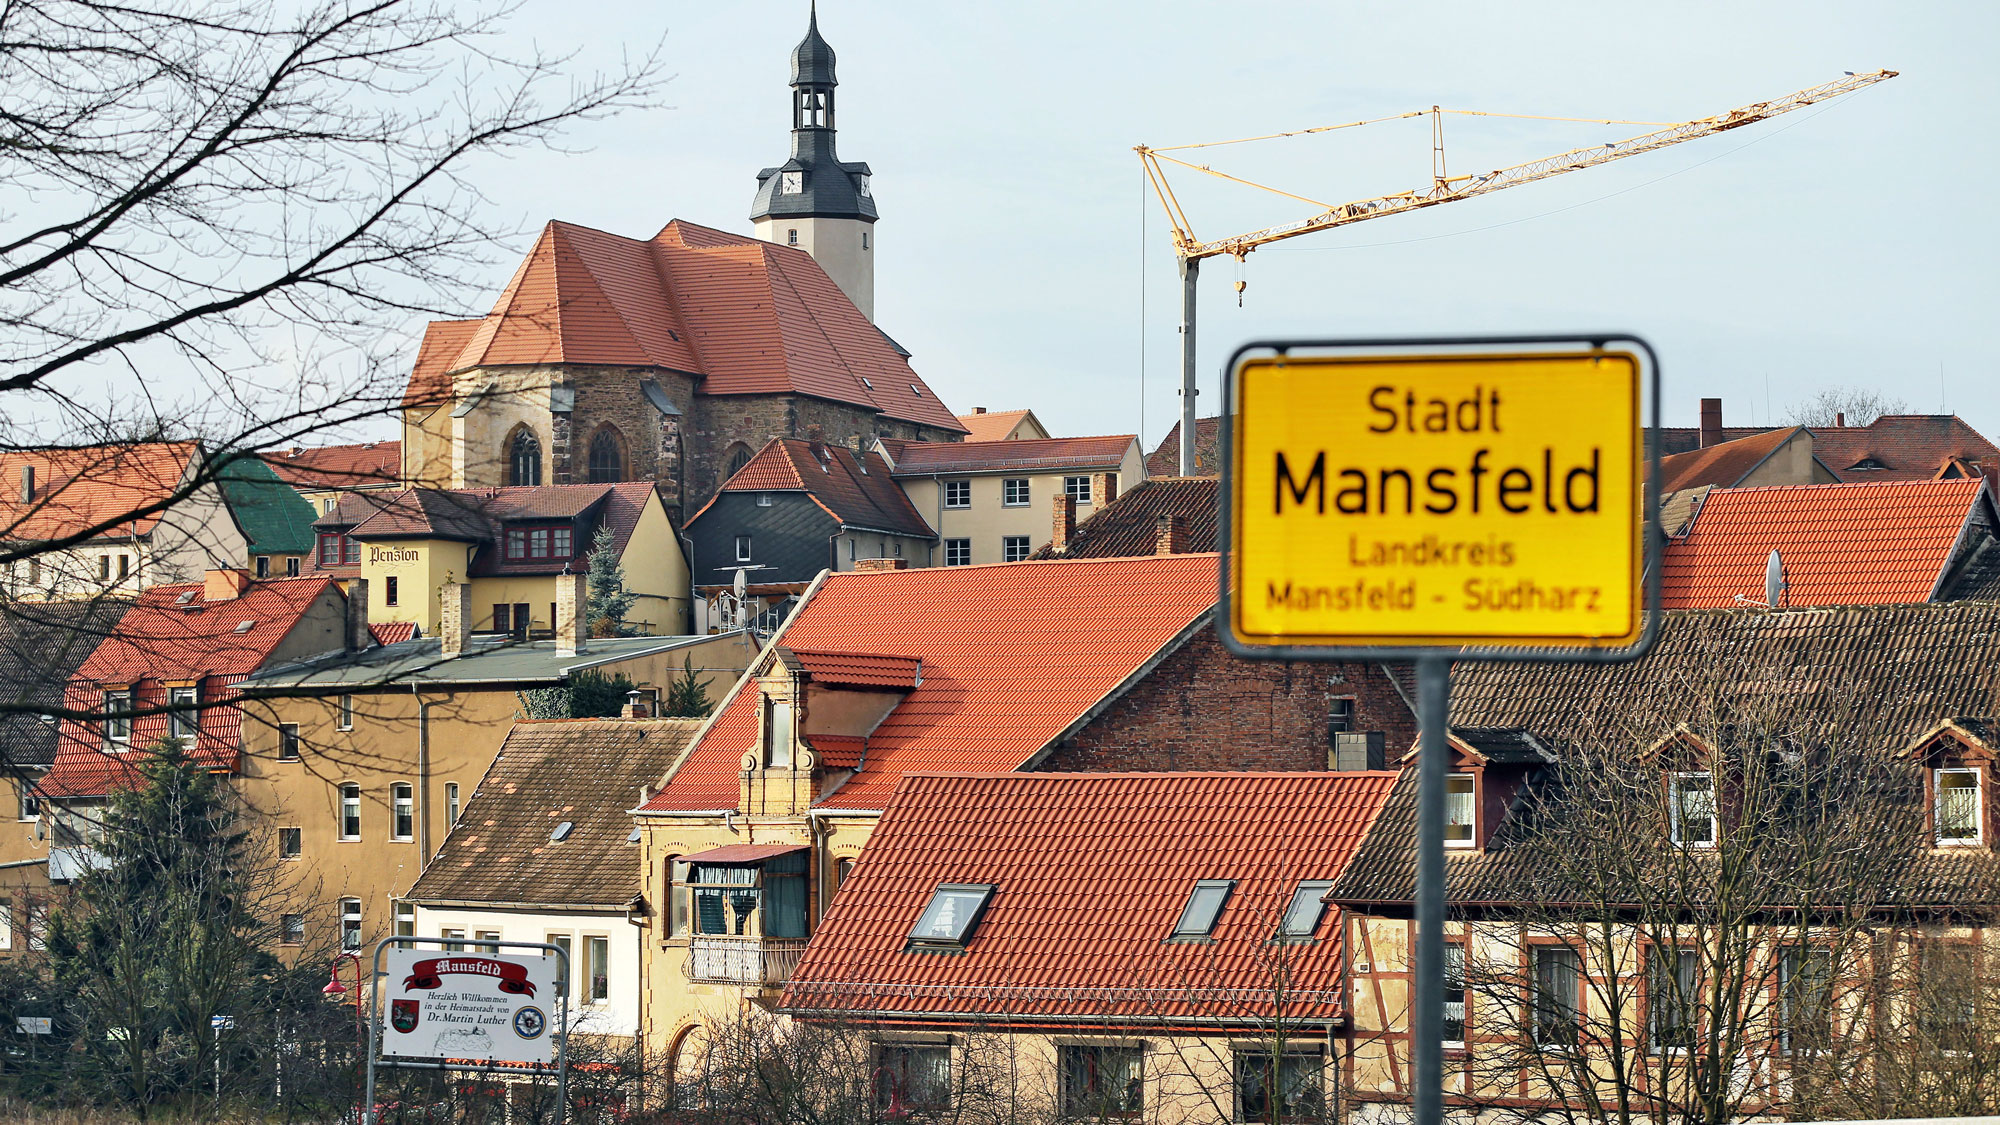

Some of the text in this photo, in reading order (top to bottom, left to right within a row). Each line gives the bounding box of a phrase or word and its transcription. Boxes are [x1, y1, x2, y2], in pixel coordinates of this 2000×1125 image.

[1368, 385, 1503, 434] Stadt
[1275, 447, 1600, 516] Mansfeld
[369, 546, 419, 566] Pension
[1349, 533, 1516, 567] Landkreis
[1267, 579, 1416, 612] Mansfeld
[1462, 577, 1603, 613] Südharz
[435, 960, 502, 976] Mansfeld
[424, 1002, 432, 1010] in
[435, 1002, 447, 1011] der
[450, 1003, 494, 1013] Heimatstadt
[427, 992, 508, 1004] Herzlich Willkommen
[478, 1015, 507, 1025] Luther
